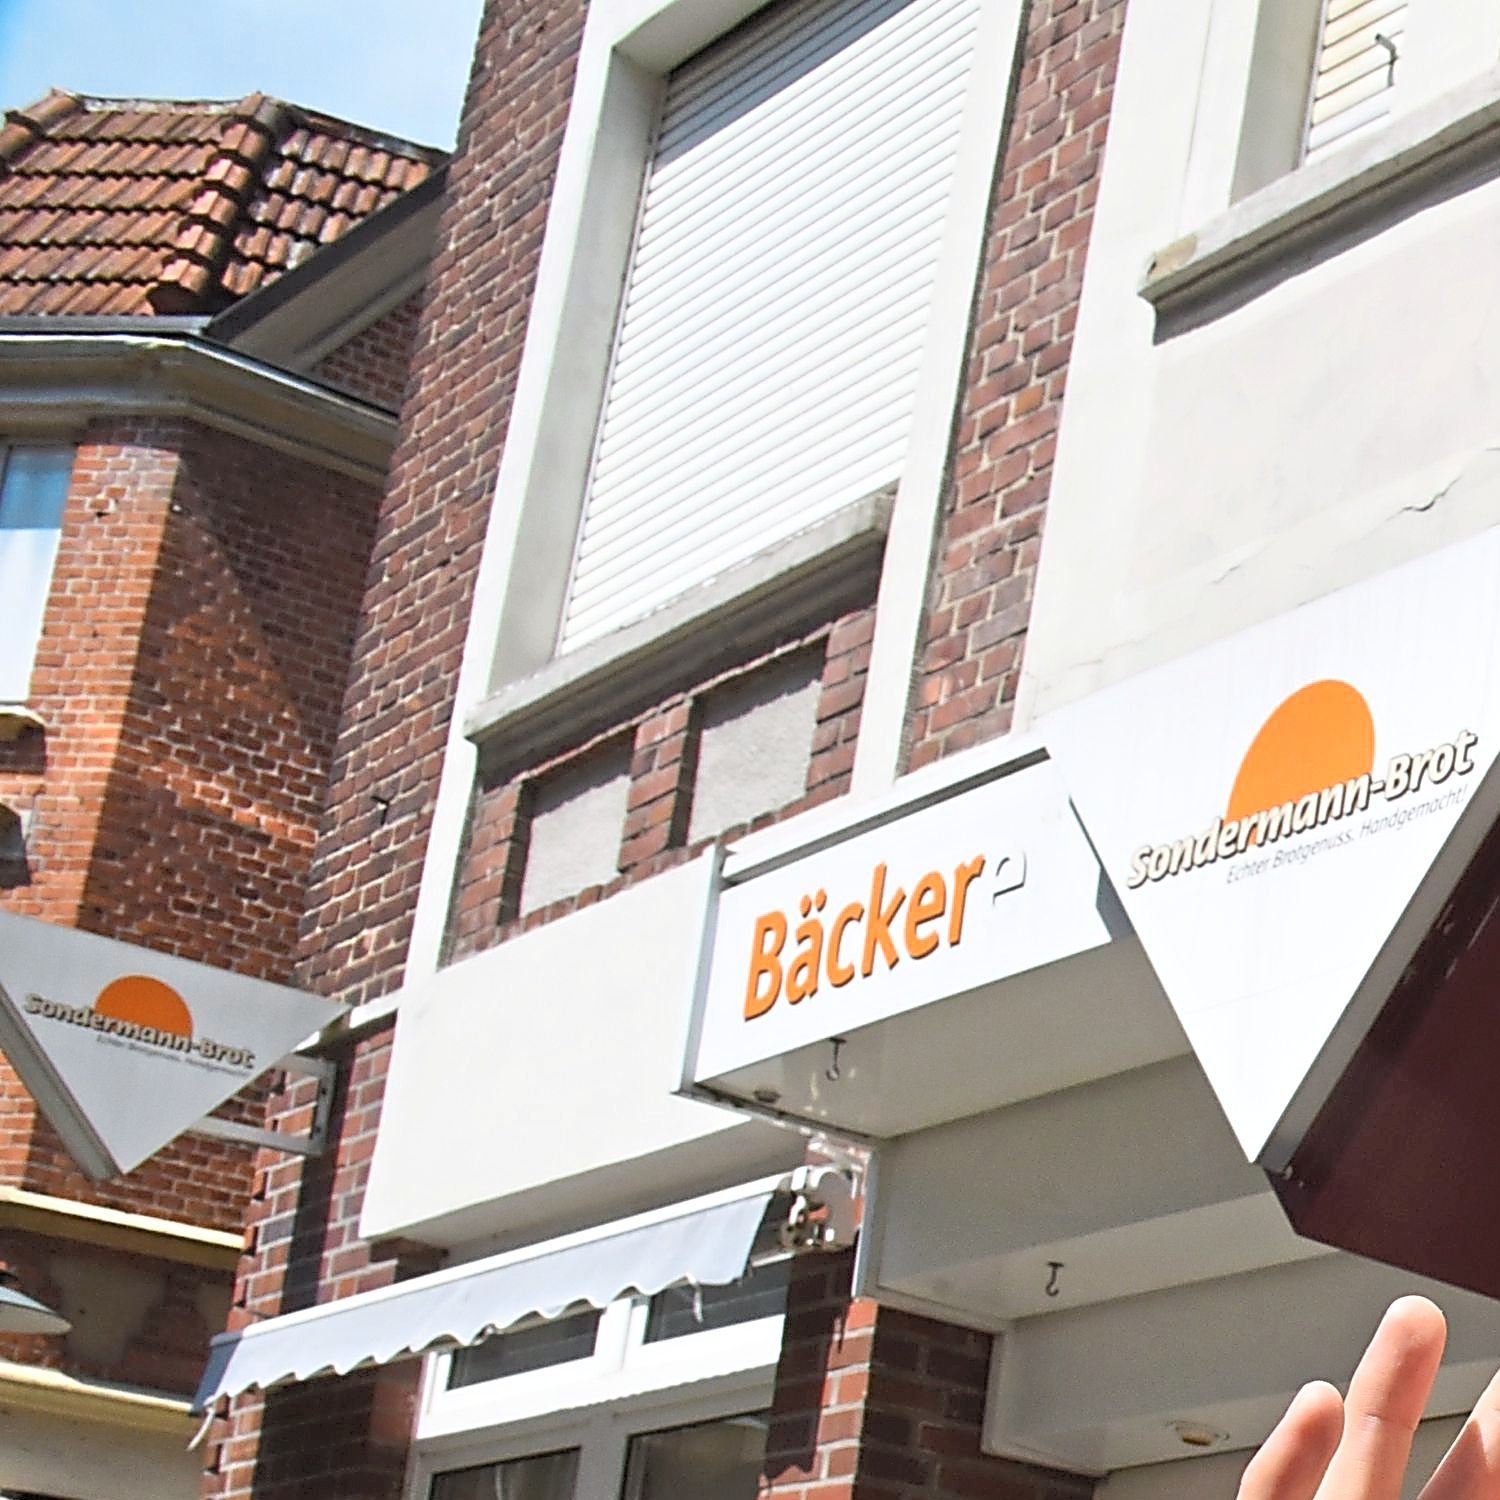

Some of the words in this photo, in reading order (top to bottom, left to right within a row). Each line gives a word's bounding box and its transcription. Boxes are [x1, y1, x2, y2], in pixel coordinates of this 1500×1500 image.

[1126, 729, 1479, 890] Sondermann-Brot
[1226, 857, 1270, 884] Echter
[1271, 831, 1355, 870] Brotgenuss.
[1359, 785, 1469, 838] Handgemacht!
[24, 993, 257, 1070] Sondermann-Brot
